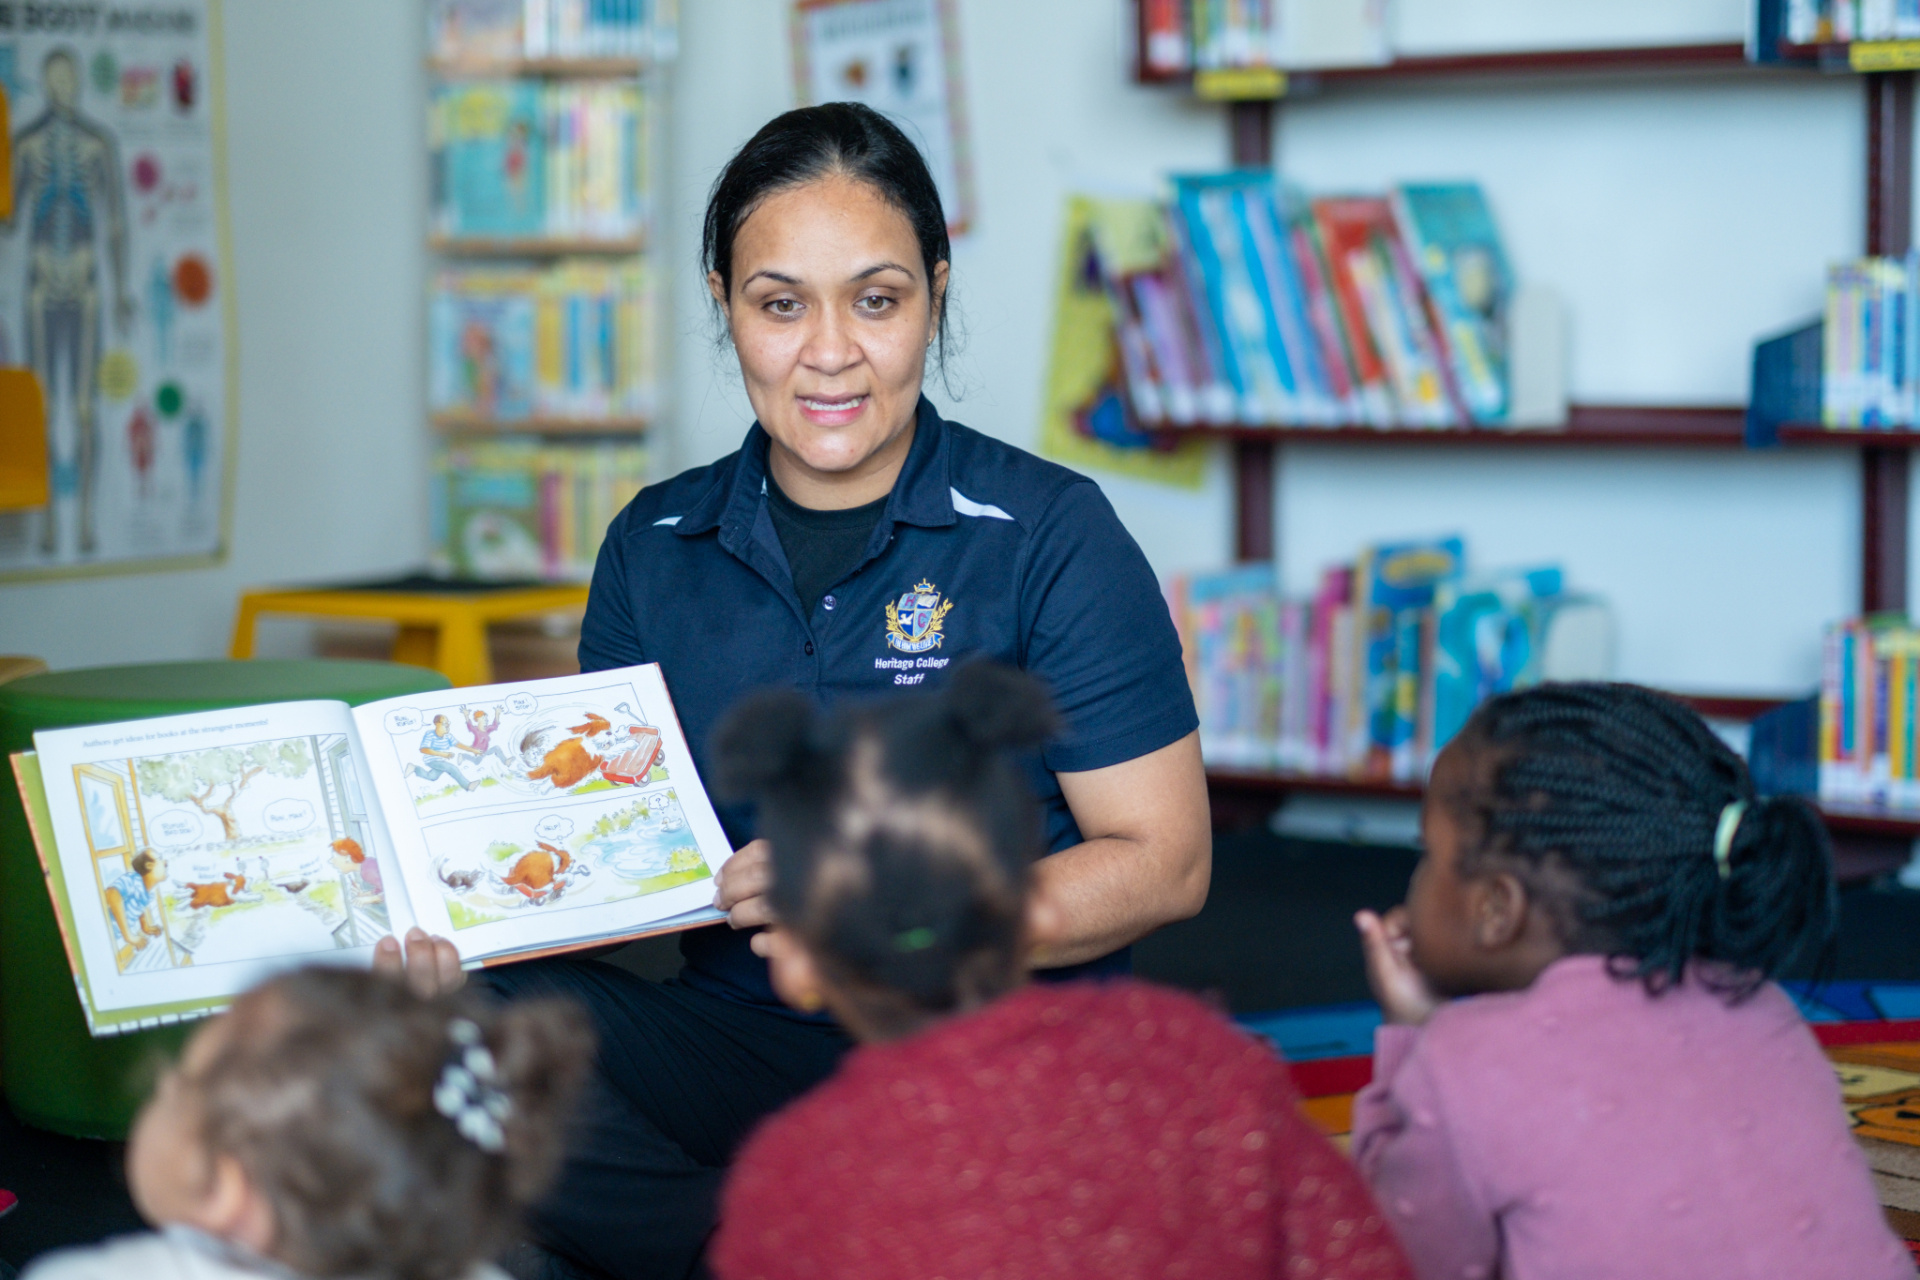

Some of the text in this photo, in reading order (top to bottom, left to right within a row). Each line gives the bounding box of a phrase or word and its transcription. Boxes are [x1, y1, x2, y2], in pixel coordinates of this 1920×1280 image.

[917, 612, 927, 628] C
[874, 657, 949, 671] Heritage College
[894, 673, 925, 685] Staff
[83, 737, 112, 749] Authors
[113, 736, 124, 746] get
[125, 735, 144, 744] ideas
[145, 732, 156, 741] for
[157, 729, 179, 739] books
[188, 727, 200, 735] the
[201, 724, 233, 735] strangest
[235, 718, 269, 730] moments!
